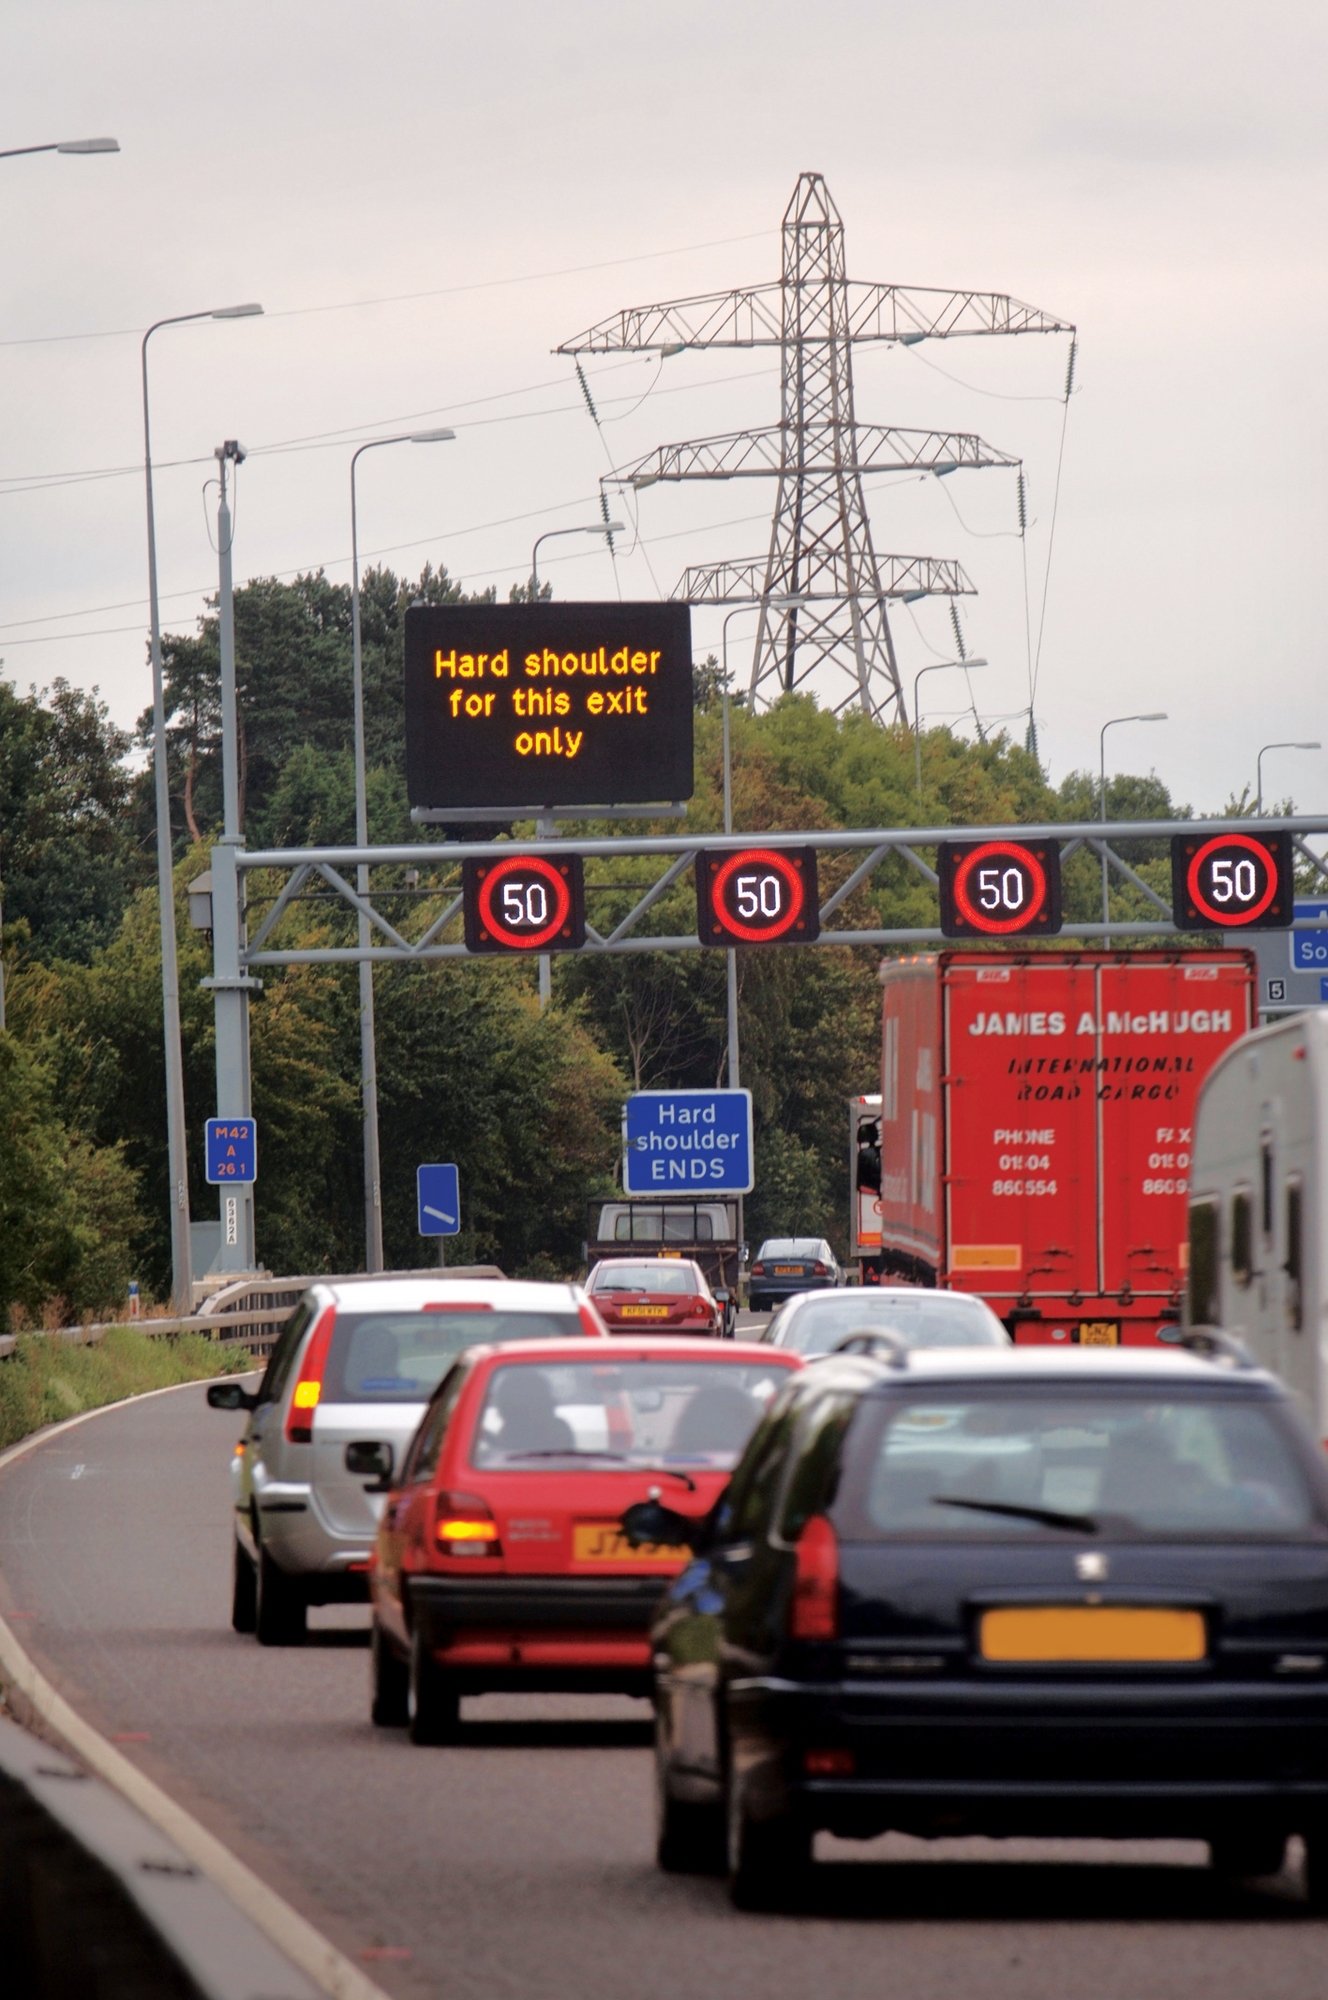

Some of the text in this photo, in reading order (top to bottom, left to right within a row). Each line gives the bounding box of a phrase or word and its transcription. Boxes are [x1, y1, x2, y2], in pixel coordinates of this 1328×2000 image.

[435, 647, 661, 678] Hard shoulder
[449, 686, 648, 717] for this exit
[515, 726, 583, 758] only
[979, 868, 1024, 910] 50
[1212, 860, 1256, 902] 50
[503, 883, 547, 925] 50
[737, 875, 781, 918] 50
[1271, 982, 1283, 999] 5
[968, 1012, 1066, 1036] JAMES
[1008, 1057, 1194, 1074] INTERNATIONAL
[1017, 1085, 1081, 1101] ROAD
[658, 1103, 716, 1125] Hard
[215, 1126, 249, 1139] M42
[636, 1129, 740, 1151] shoulder
[993, 1128, 1055, 1145] PHONE
[226, 1144, 236, 1157] A
[651, 1158, 726, 1180] ENDS
